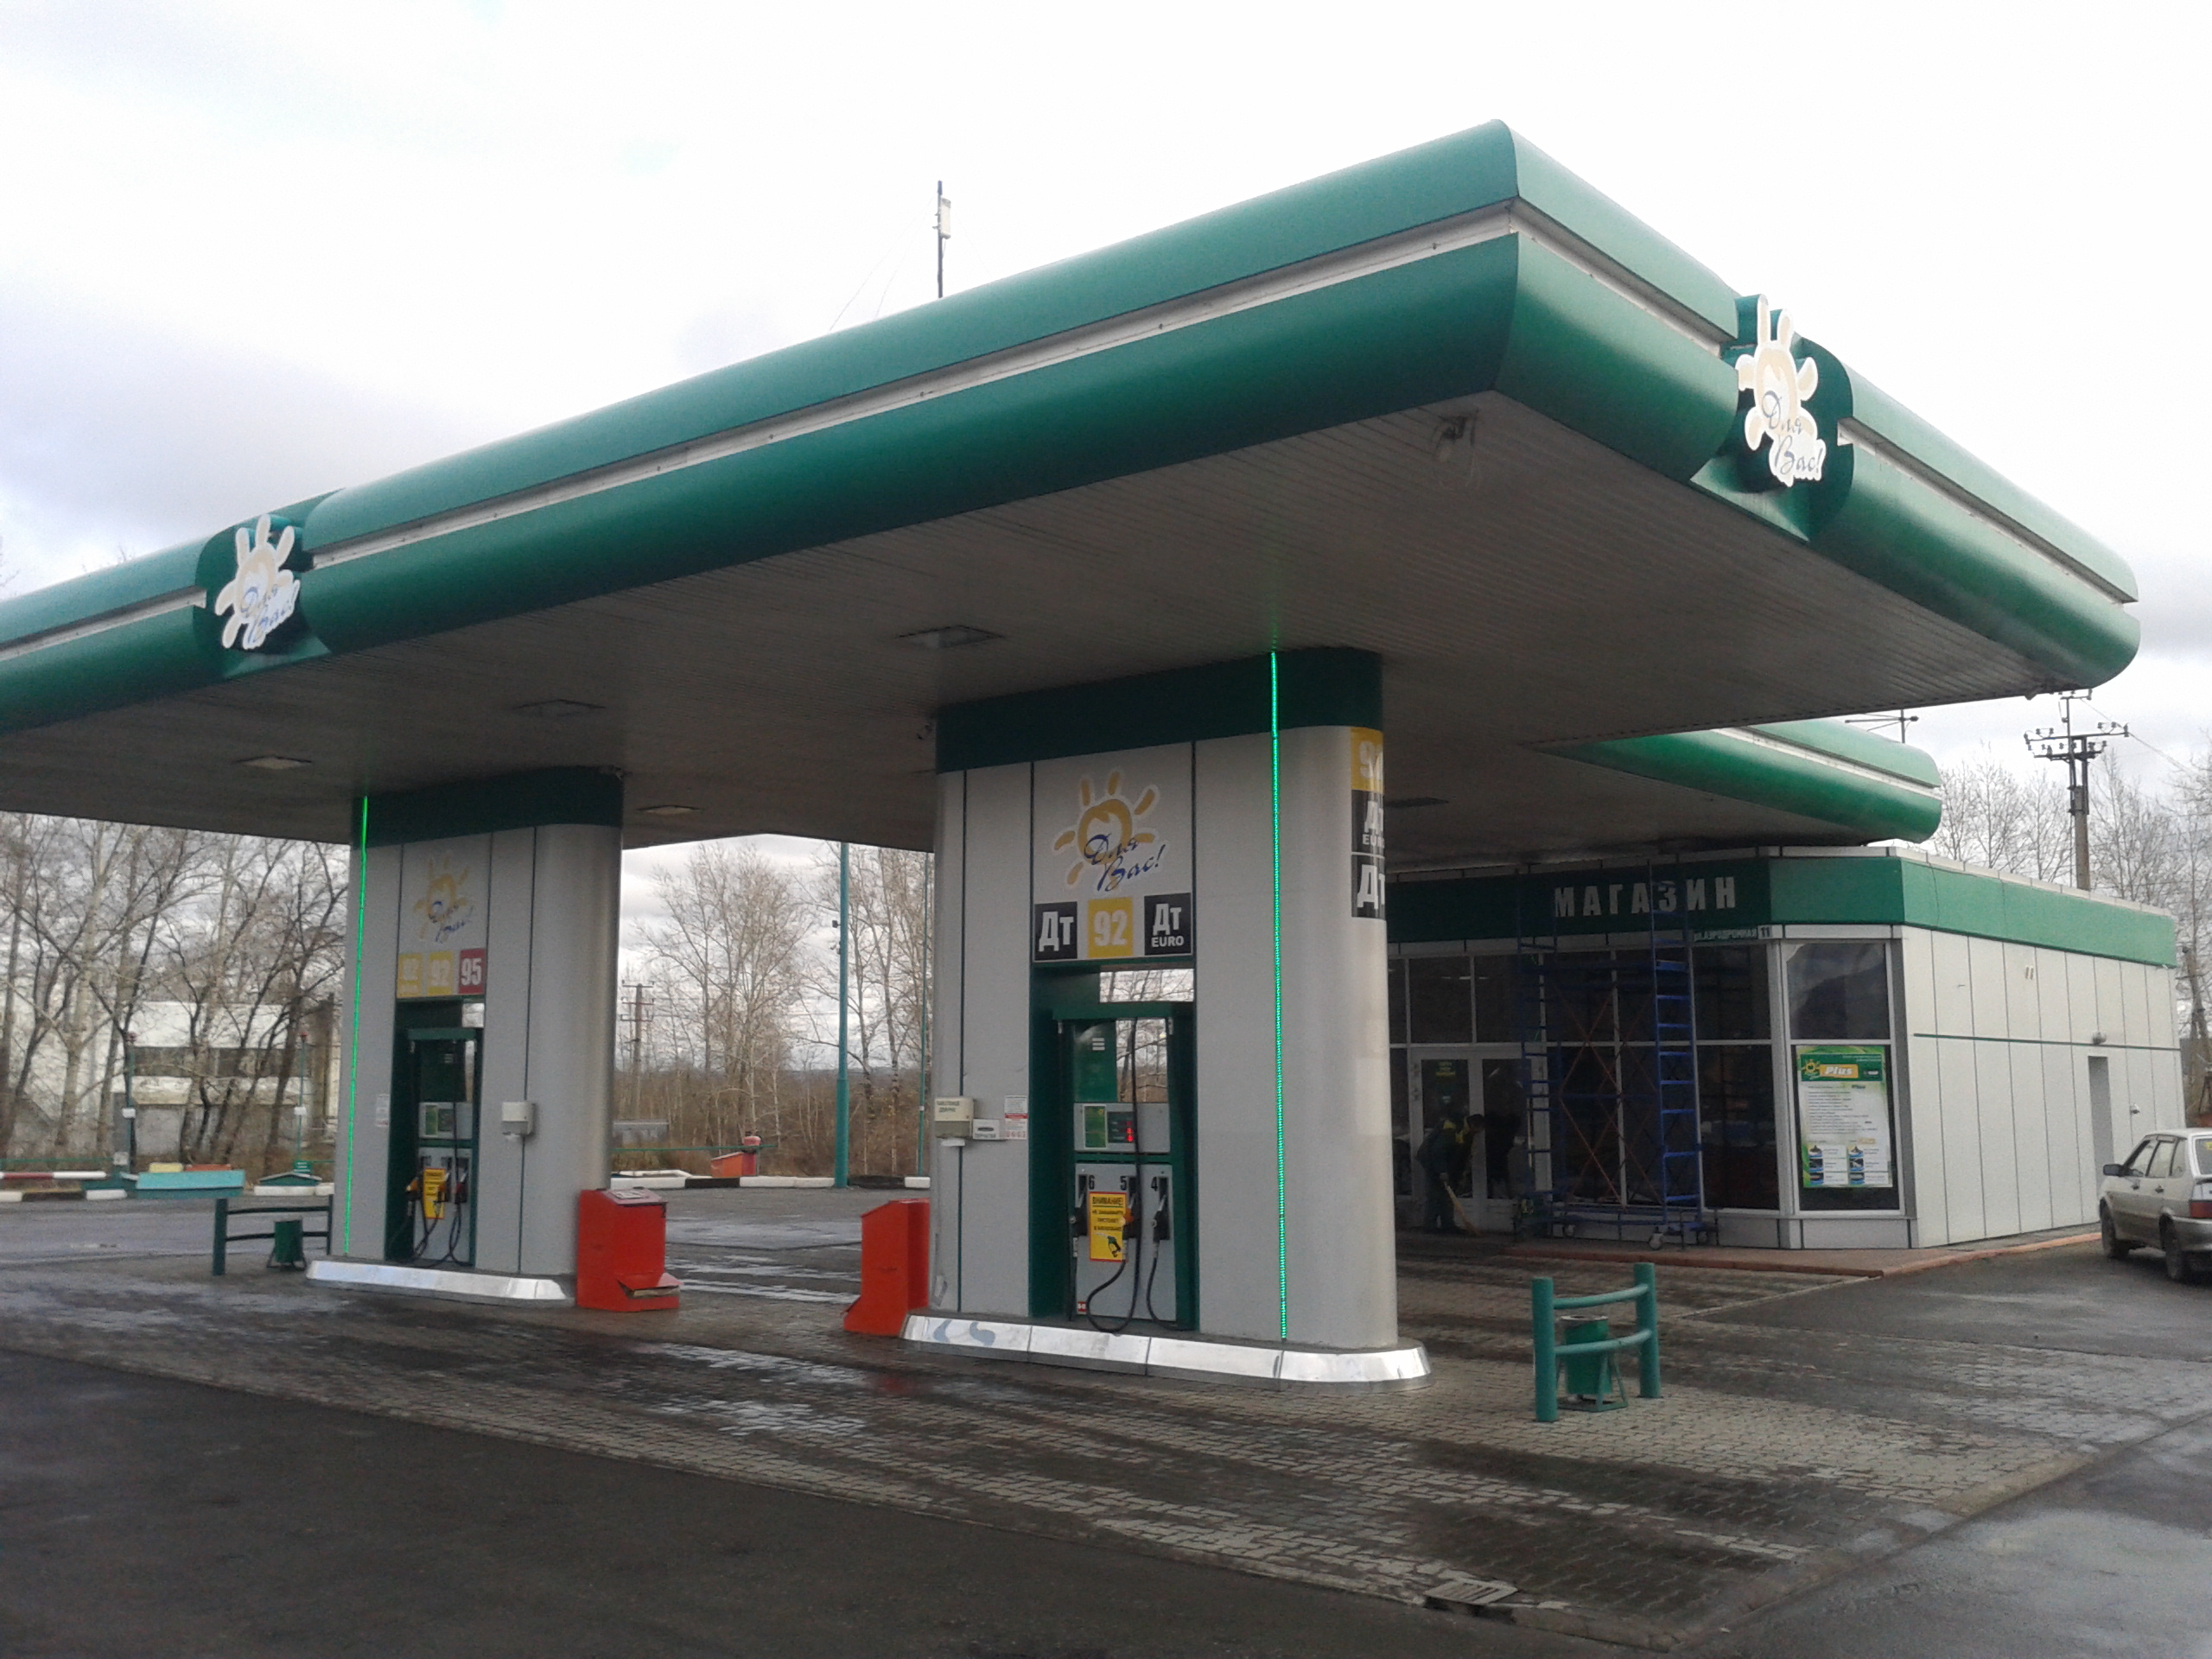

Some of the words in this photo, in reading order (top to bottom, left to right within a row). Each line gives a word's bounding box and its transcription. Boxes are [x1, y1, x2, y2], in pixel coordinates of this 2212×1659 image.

[1762, 391, 1803, 434] Для
[1774, 435, 1823, 474] Вас!
[1084, 833, 1140, 865] Для
[1363, 834, 1385, 849] EUR
[1097, 844, 1166, 892] Вас!
[1555, 876, 1735, 918] МАГАЗИН
[1094, 909, 1128, 947] 92
[1151, 936, 1185, 948] EURO
[461, 957, 482, 986] 95
[1824, 1066, 1853, 1076] Plus
[1089, 1175, 1095, 1190] 6
[1120, 1176, 1127, 1191] 5
[1151, 1176, 1158, 1192] 4
